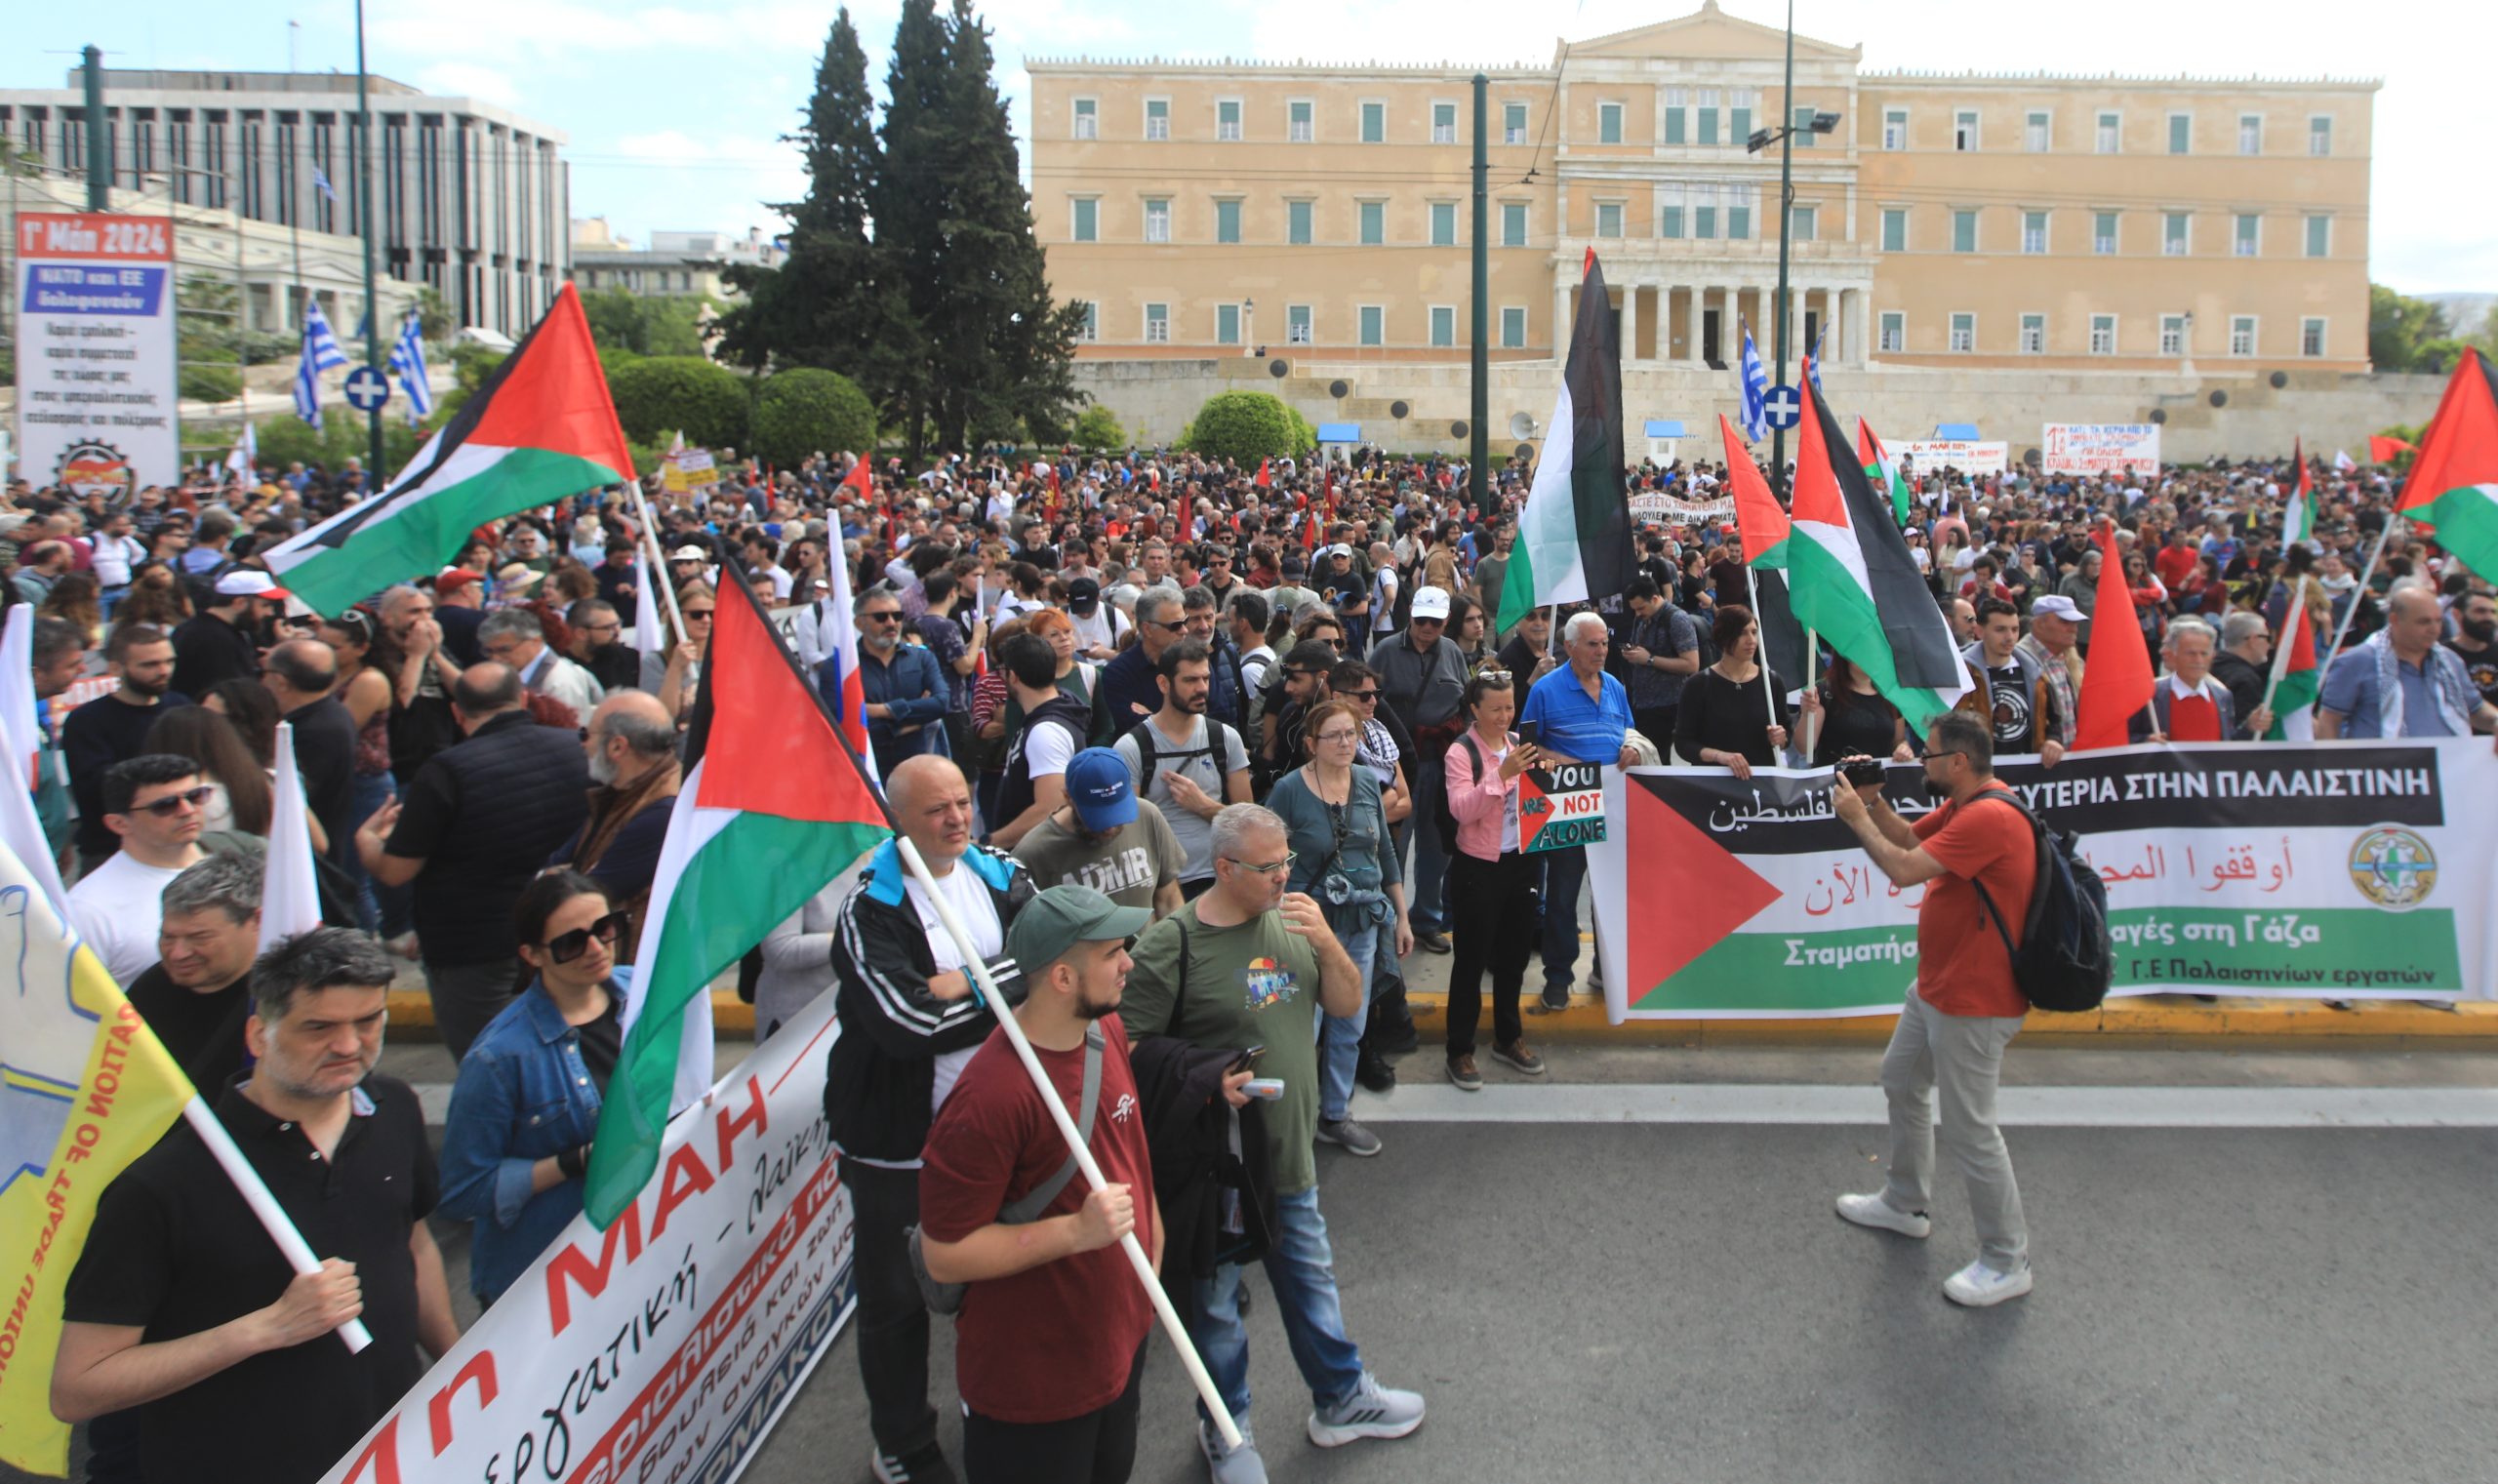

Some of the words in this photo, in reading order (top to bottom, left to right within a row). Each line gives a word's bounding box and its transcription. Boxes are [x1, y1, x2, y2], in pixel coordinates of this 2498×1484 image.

[47, 219, 97, 252] Μάη
[103, 222, 167, 255] 2024
[118, 269, 144, 287] ΕΕ
[1720, 499, 1735, 508] ΜΑ
[1550, 765, 1594, 790] YOU
[2124, 771, 2209, 801] ΣΤΗΝ
[2215, 768, 2431, 798] ΠΑΛΑΙΣΤΙΝΗ
[1522, 796, 1547, 816] ARE
[1563, 792, 1600, 816] NOT
[1539, 820, 1605, 849] ALONE
[2183, 923, 2236, 947] στη
[2244, 914, 2320, 948] Γάζα
[2170, 959, 2325, 983] Παλαιστινίων
[2333, 964, 2436, 986] εργατών
[545, 1073, 767, 1339] ΜΑΗ
[766, 1261, 798, 1316] και
[806, 1192, 843, 1260] ζωή
[722, 1262, 824, 1415] αναγκών
